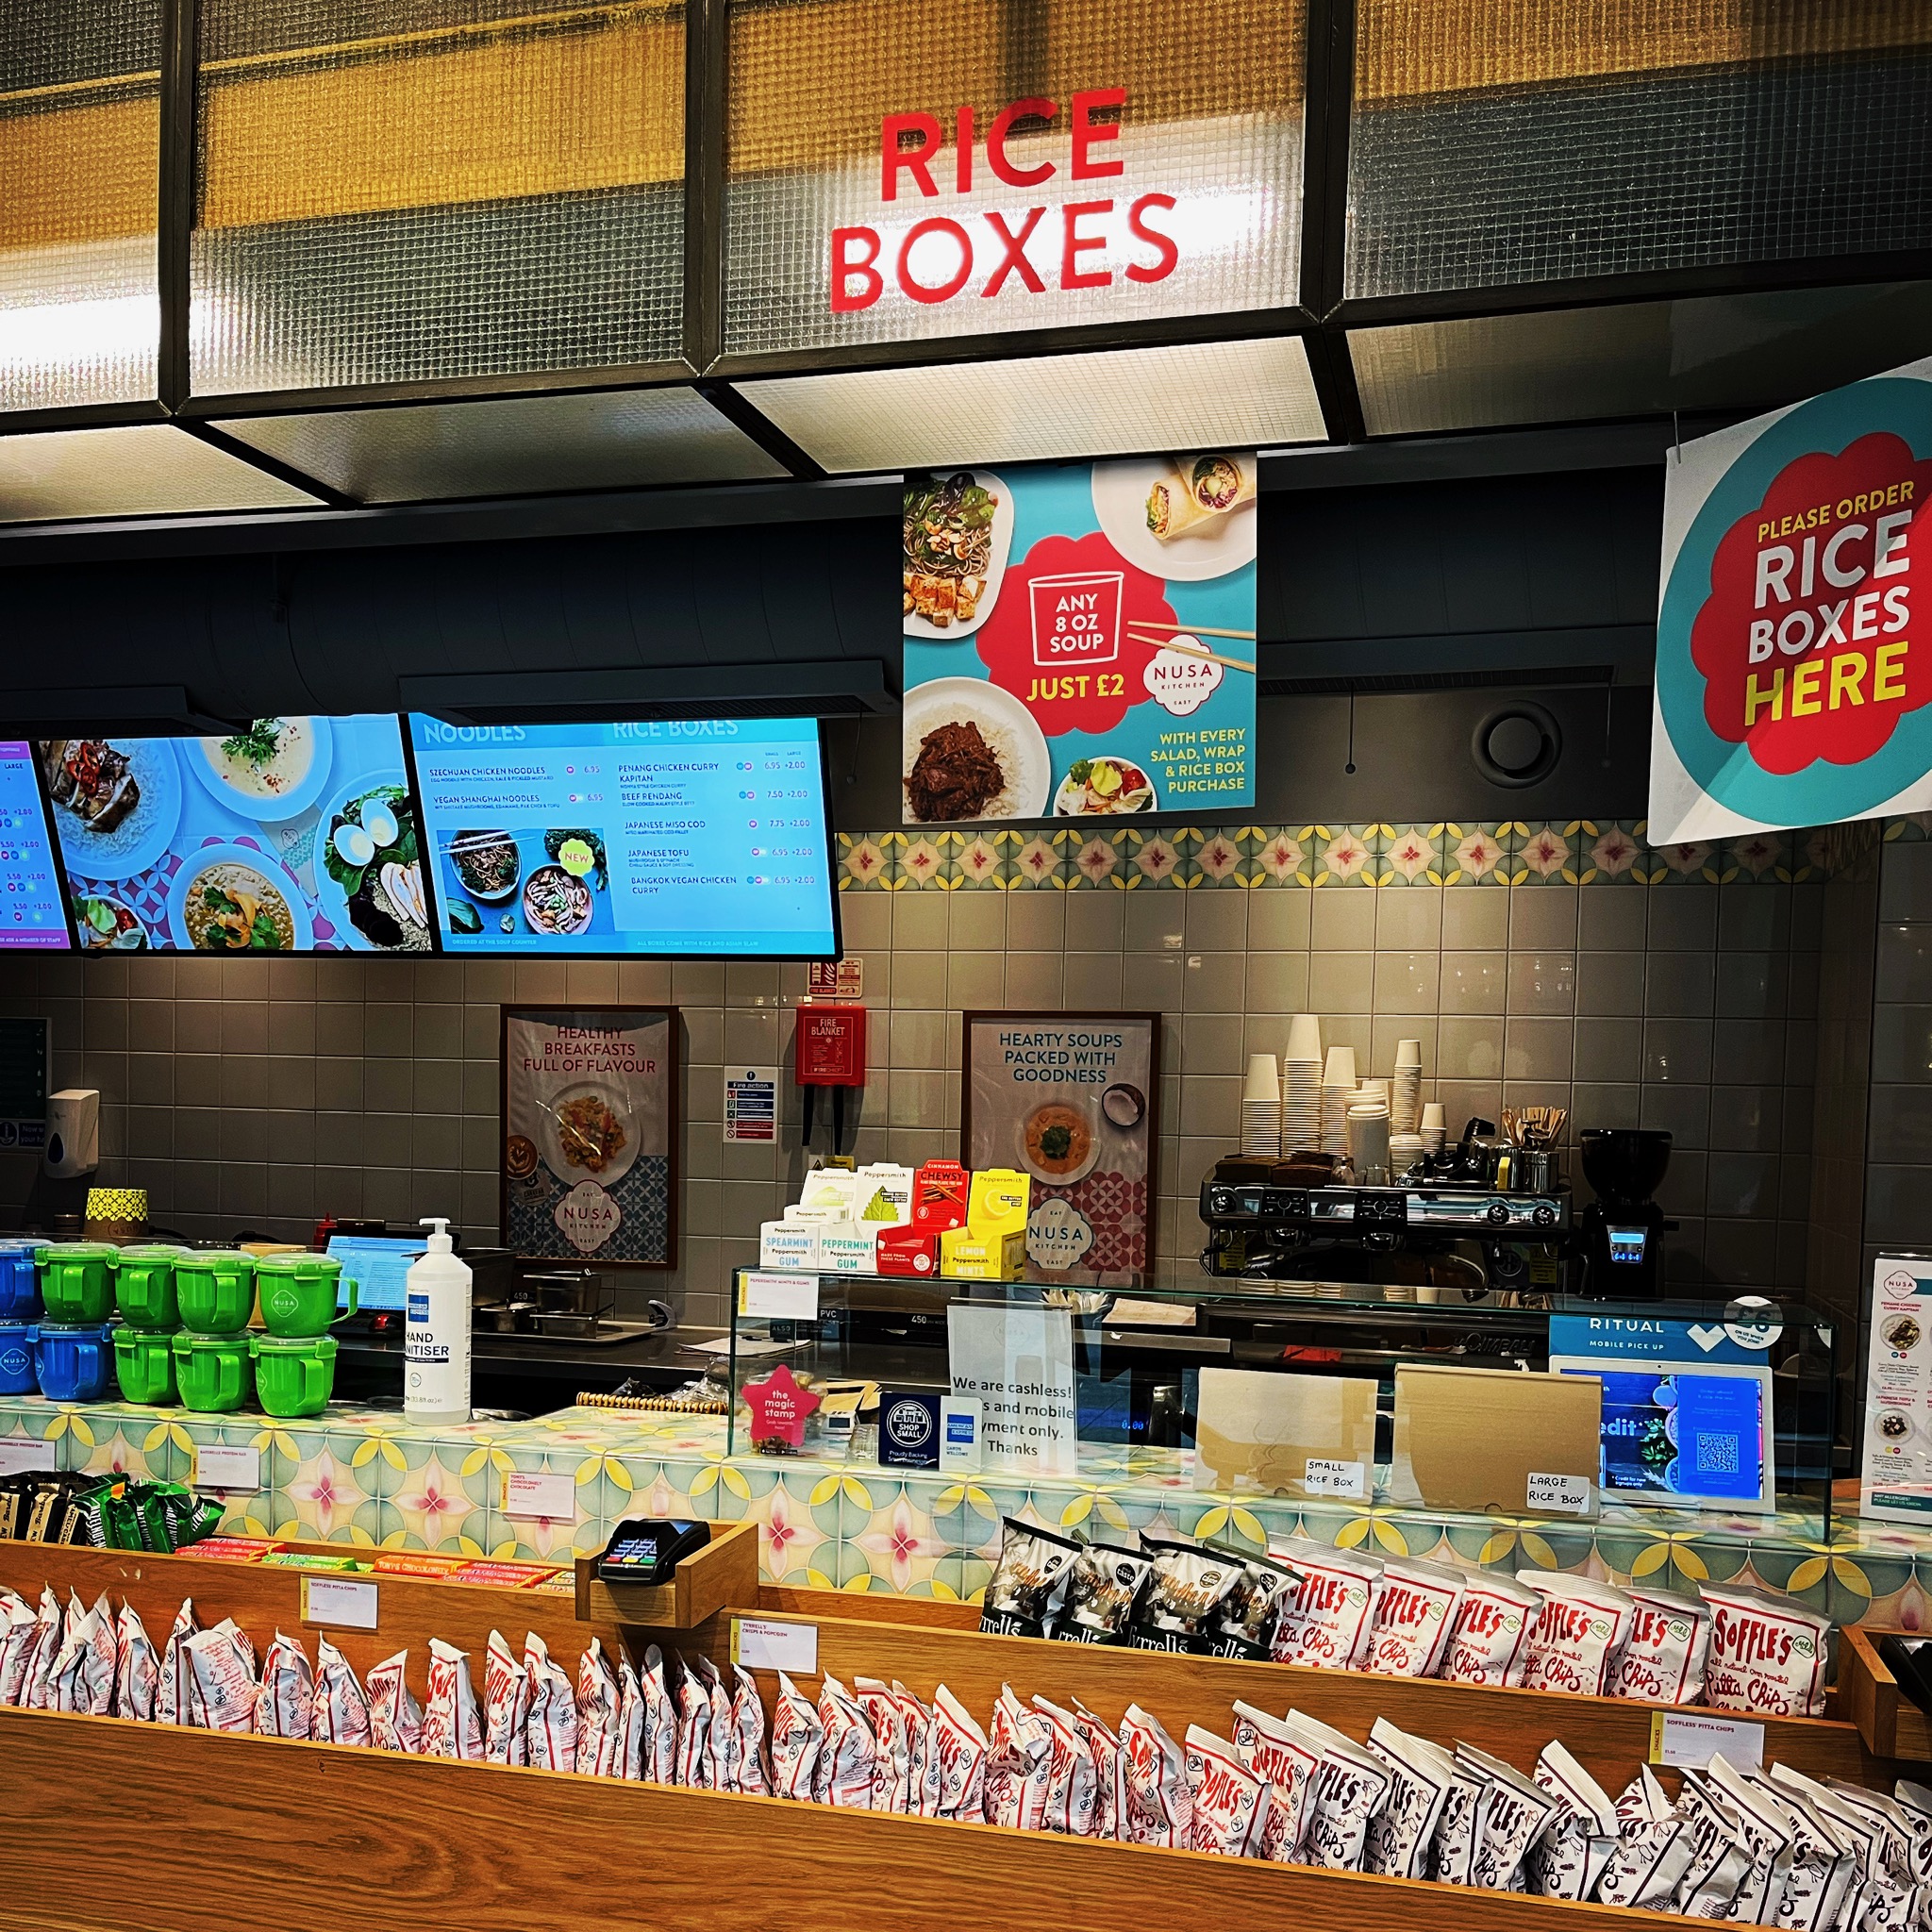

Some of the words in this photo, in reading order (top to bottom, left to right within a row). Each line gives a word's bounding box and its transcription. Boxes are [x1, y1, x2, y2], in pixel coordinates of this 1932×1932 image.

[882, 87, 1127, 202] RICE
[830, 192, 1178, 315] BOXES
[1757, 503, 1831, 544] PLEASE
[1836, 480, 1916, 521] ORDER
[1753, 509, 1913, 611] RICE
[1055, 592, 1098, 614] ANY
[1055, 617, 1067, 633] 8
[1071, 613, 1099, 632] OZ
[1748, 585, 1911, 665] BOXES
[1049, 633, 1105, 655] SOUP
[1154, 663, 1213, 680] NUSA
[1025, 675, 1091, 702] JUST
[1097, 673, 1125, 696] £2
[1744, 641, 1909, 727] HERE
[424, 723, 526, 743] NOODLES
[613, 722, 662, 739] RICE
[668, 720, 740, 738] BOXES
[1159, 731, 1196, 745] WITH
[1200, 727, 1246, 743] EVERY
[1150, 747, 1201, 763] SALAD,
[1204, 744, 1246, 758] WRAP
[429, 768, 471, 776] SZECHUAN
[472, 767, 507, 775] CHICKEN
[508, 766, 545, 774] NOODLES
[584, 764, 601, 774] 6.95
[653, 763, 691, 772] CHICKEN
[691, 762, 720, 771] CURRY
[764, 761, 781, 770] 6.95
[1165, 765, 1175, 777] &
[1178, 762, 1211, 776] RICE
[1215, 760, 1245, 774] BOX
[1168, 777, 1245, 794] PURCHASE
[433, 795, 459, 804] VEGAN
[460, 795, 502, 804] SHANGHAI
[502, 794, 541, 803] NOODLES
[587, 793, 604, 802] 6.95
[642, 791, 683, 800] RENDANG
[625, 821, 664, 829] JAPANESE
[687, 820, 706, 828] COD
[564, 852, 590, 863] NEW
[627, 849, 667, 858] JAPANESE
[772, 848, 789, 857] 6.95
[631, 876, 671, 885] BANGKOK
[700, 875, 737, 884] CHICKEN
[819, 1018, 838, 1027] FIRE
[557, 1026, 624, 1040] HEALTHY
[810, 1026, 845, 1036] BLANKET
[999, 1032, 1064, 1047] HEARTY
[1067, 1033, 1123, 1049] SOUPS
[544, 1042, 636, 1057] BREAKFASTS
[1005, 1050, 1070, 1065] PACKED
[1074, 1051, 1116, 1066] WITH
[524, 1058, 559, 1072] FULL
[563, 1058, 583, 1072] OF
[587, 1059, 656, 1074] FLAVOUR
[1012, 1068, 1108, 1083] GOODNESS
[864, 1171, 908, 1179] Peppersmith
[920, 1171, 965, 1181] CHEWSY
[979, 1175, 1024, 1184] Peppersmith
[563, 1208, 613, 1222] NUSA
[1028, 1225, 1084, 1241] NUSA
[765, 1237, 813, 1248] SPEARMINT
[822, 1239, 874, 1251] PEPPERMINT
[1035, 1243, 1076, 1252] KITCHEN
[955, 1245, 986, 1257] LEMON
[778, 1256, 800, 1267] GUM
[837, 1258, 858, 1269] GUM
[952, 1257, 990, 1265] Peppersmith
[956, 1265, 985, 1277] MINTS
[820, 1309, 837, 1318] PVC
[911, 1315, 927, 1324] 450
[1735, 1306, 1772, 1333] £6
[1590, 1318, 1664, 1333] RITUAL
[406, 1332, 434, 1343] HAND
[406, 1345, 450, 1357] NITISER
[1590, 1341, 1624, 1349] MOBILE
[1627, 1341, 1649, 1350] PICK
[953, 1376, 976, 1390] We
[981, 1381, 1004, 1391] are
[1008, 1382, 1072, 1398] cashless!
[772, 1390, 789, 1400] the
[764, 1399, 796, 1409] magic
[994, 1402, 1021, 1414] and
[1025, 1405, 1074, 1419] mobile
[764, 1408, 796, 1420] stamp
[896, 1430, 922, 1439] SMALL
[898, 1423, 920, 1432] SHOP
[982, 1422, 1025, 1433] yment
[1028, 1425, 1064, 1441] only.
[889, 1450, 908, 1458] Proudly
[987, 1440, 1038, 1456] Thanks
[1307, 1474, 1327, 1484] RICE
[1333, 1476, 1354, 1488] BOX
[1529, 1475, 1568, 1488] LARGE
[1528, 1490, 1555, 1502] RICE
[1560, 1494, 1585, 1507] BOX
[378, 1560, 401, 1571] TONY'S
[401, 1563, 450, 1576] CHOCOLONELY
[1303, 1625, 1338, 1658] Chips
[1714, 1608, 1794, 1666] SOFFLE'S
[1378, 1639, 1412, 1670] Chips
[1454, 1649, 1490, 1684] Chips
[1544, 1657, 1584, 1692] Chips
[1622, 1660, 1663, 1696] Chips
[1705, 1668, 1744, 1697] Pitta
[1747, 1678, 1791, 1716] Chips
[1314, 1819, 1347, 1859] Chips
